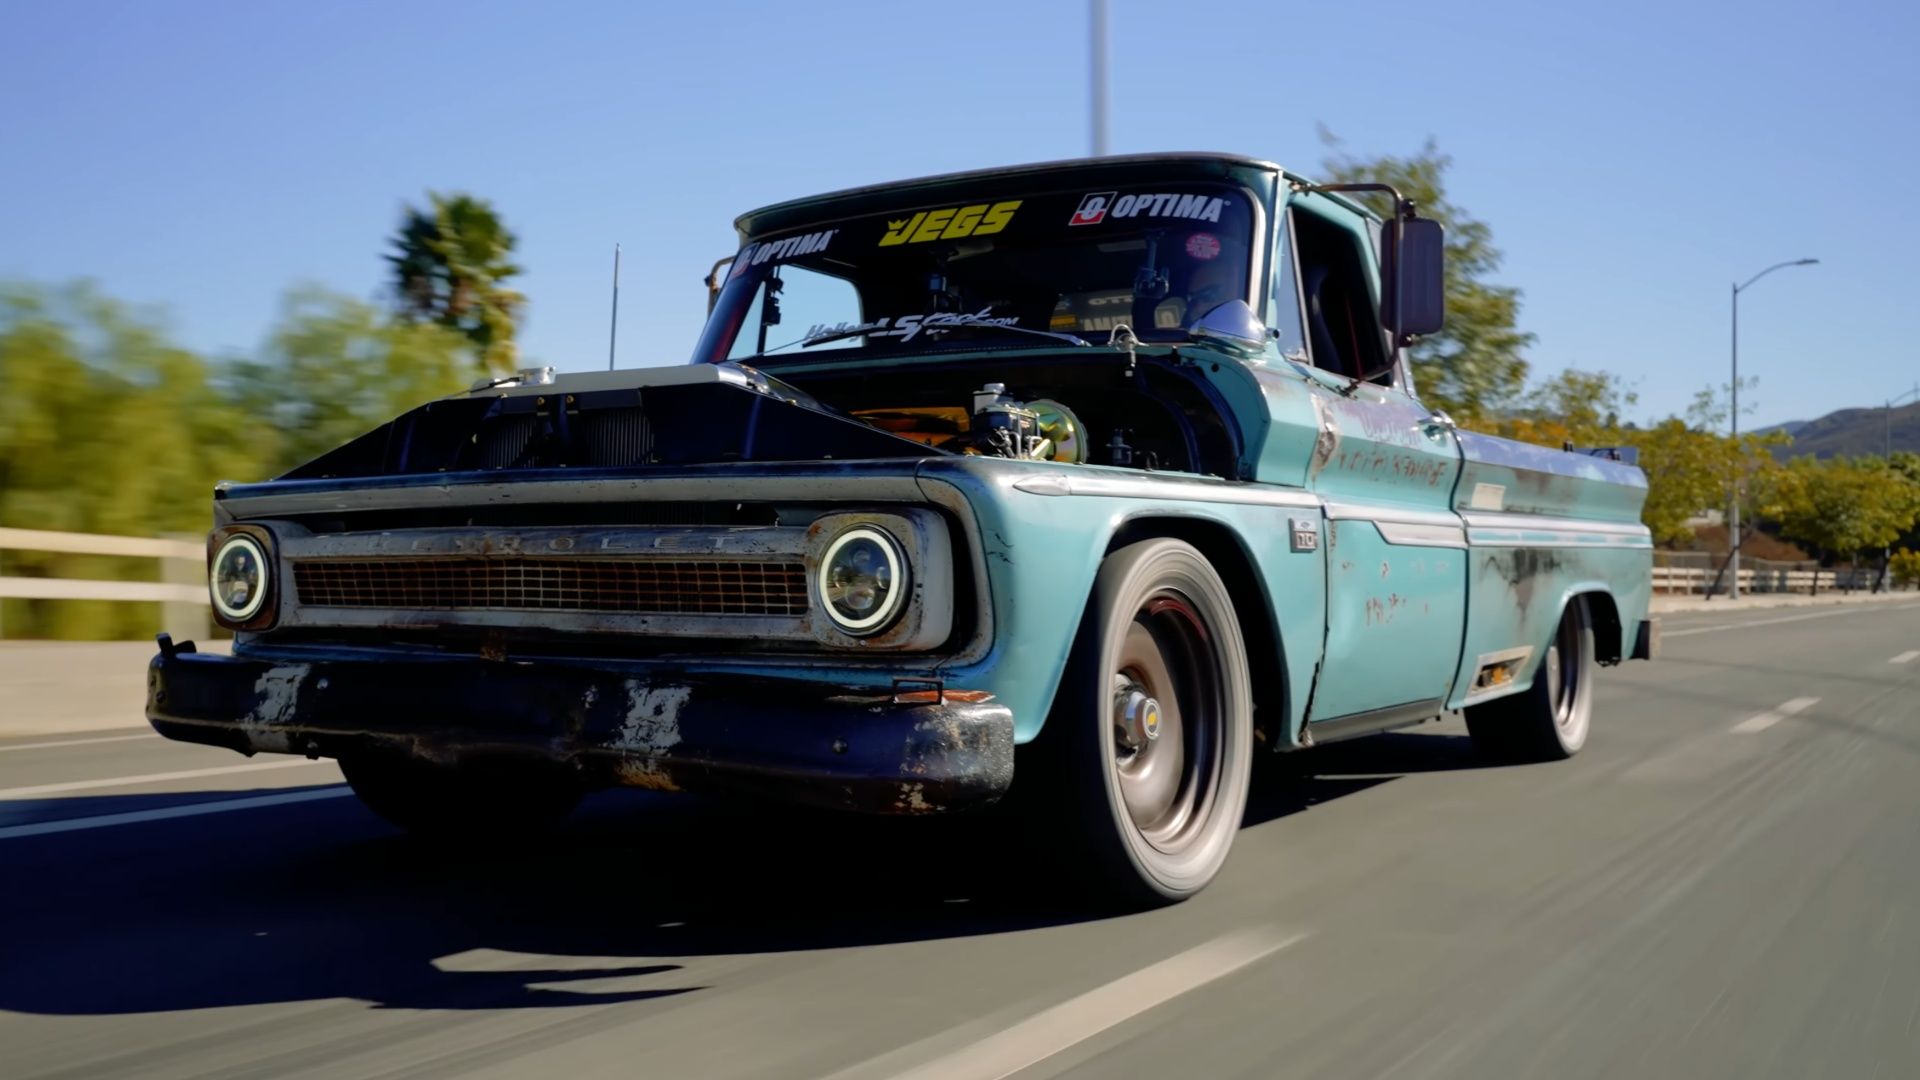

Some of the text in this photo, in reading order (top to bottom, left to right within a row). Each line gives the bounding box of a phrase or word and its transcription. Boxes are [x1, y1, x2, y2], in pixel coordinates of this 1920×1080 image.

[879, 200, 1023, 247] JEGS
[1111, 194, 1224, 223] OPTIMA
[751, 229, 835, 266] OPTIMA
[1297, 534, 1314, 547] 10
